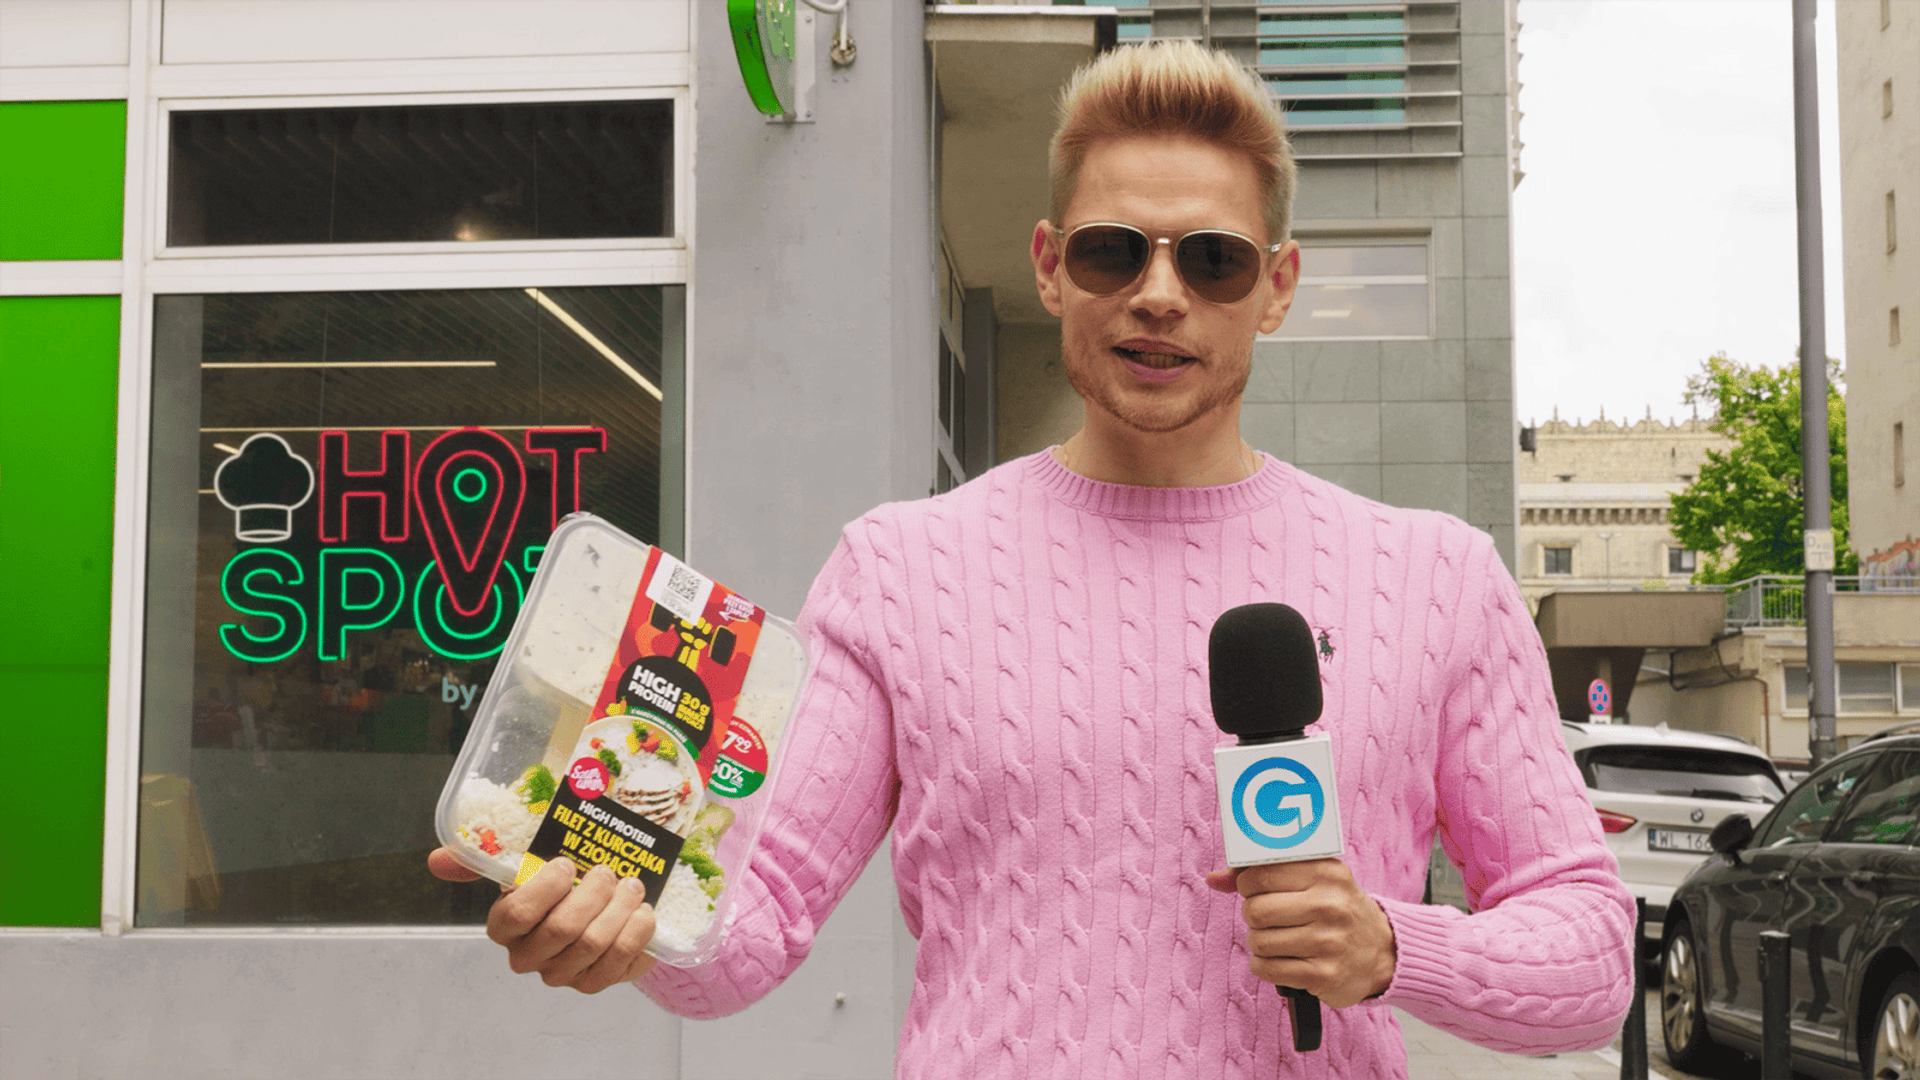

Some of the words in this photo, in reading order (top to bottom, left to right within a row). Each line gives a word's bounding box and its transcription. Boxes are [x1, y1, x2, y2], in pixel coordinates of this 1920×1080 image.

[318, 426, 609, 545] HOT
[441, 677, 478, 711] by
[628, 680, 677, 715] PROTEIN
[632, 664, 682, 703] HIGH
[553, 803, 586, 832] FILET
[582, 821, 597, 838] Z
[592, 825, 667, 875] KURCZAKA
[578, 800, 611, 825] HIGH
[608, 815, 657, 849] PROTEIN
[1659, 831, 1679, 849] WL
[562, 830, 584, 851] W
[578, 839, 642, 878] ZIOŁACH
